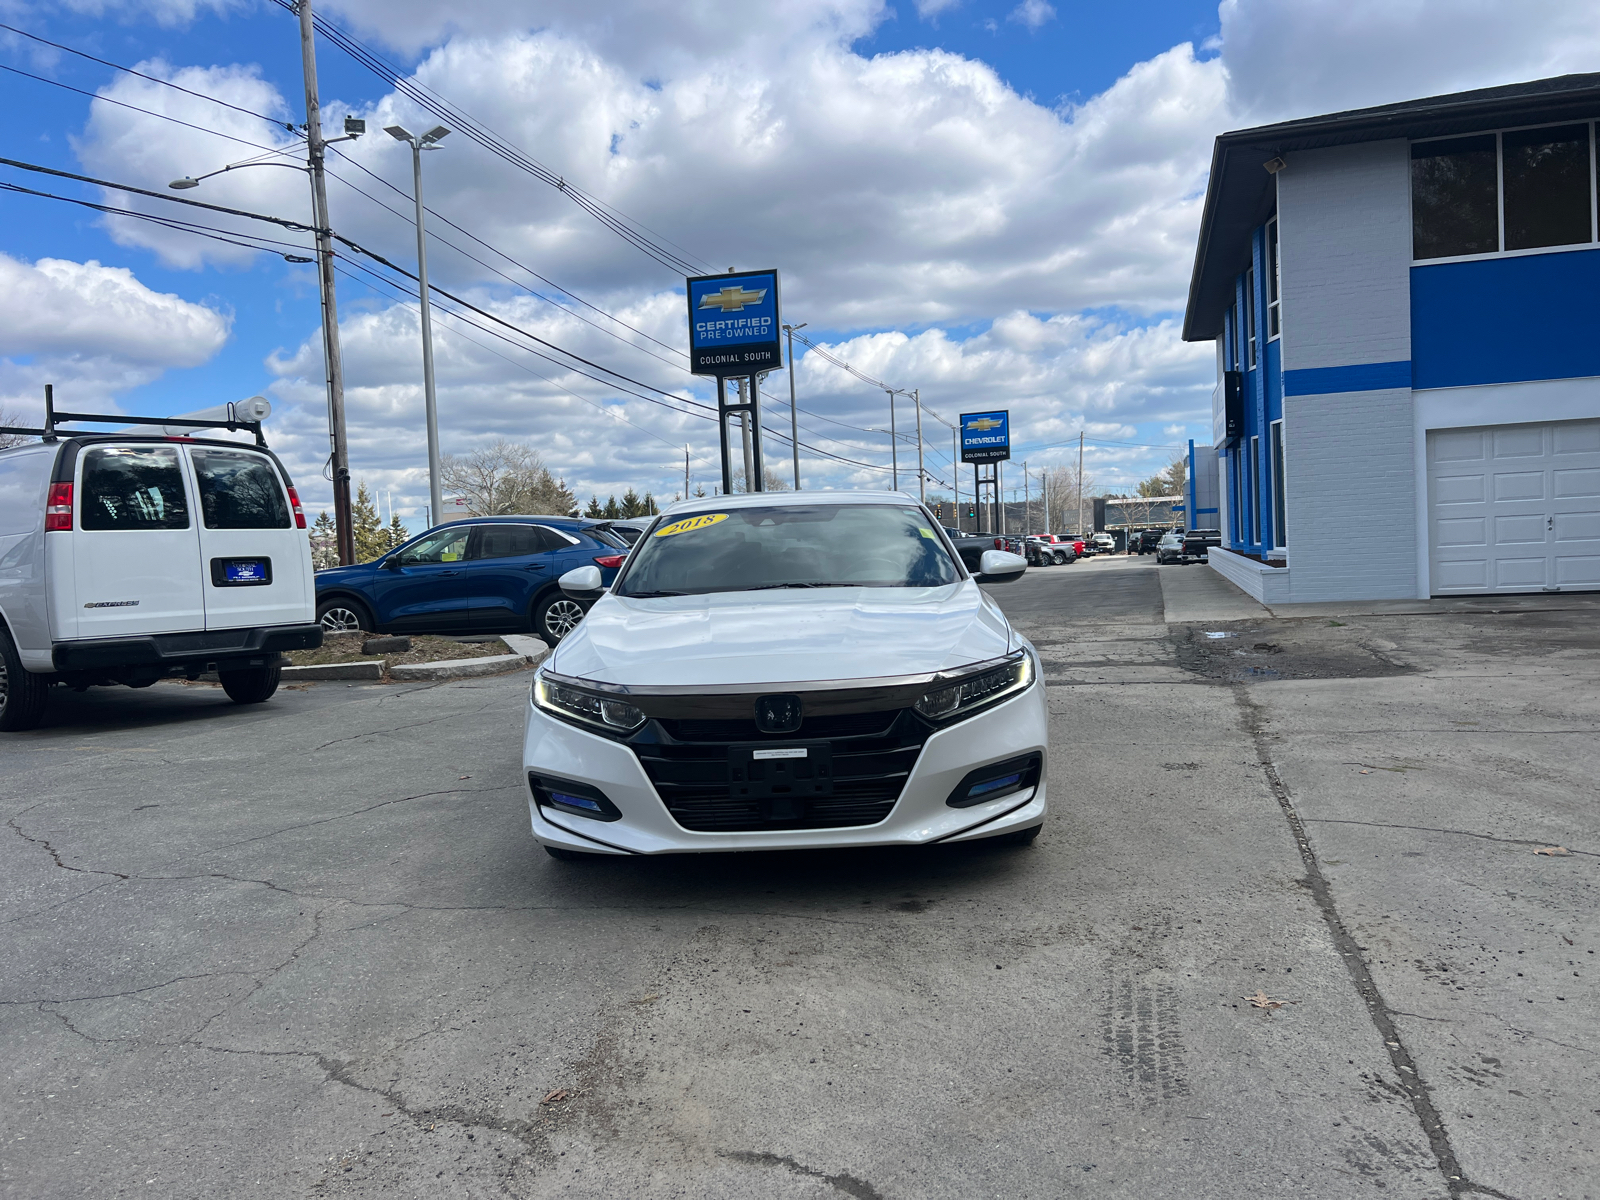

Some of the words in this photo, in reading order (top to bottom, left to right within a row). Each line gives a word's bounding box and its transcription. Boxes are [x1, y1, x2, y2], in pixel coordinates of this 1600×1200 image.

[696, 317, 771, 331] CERTIFIED
[700, 326, 768, 340] PRE-OWNED
[700, 354, 740, 365] COLONIAL
[744, 352, 771, 361] SOUTH
[965, 436, 1006, 445] CHEVROLET
[668, 515, 716, 534] 2018
